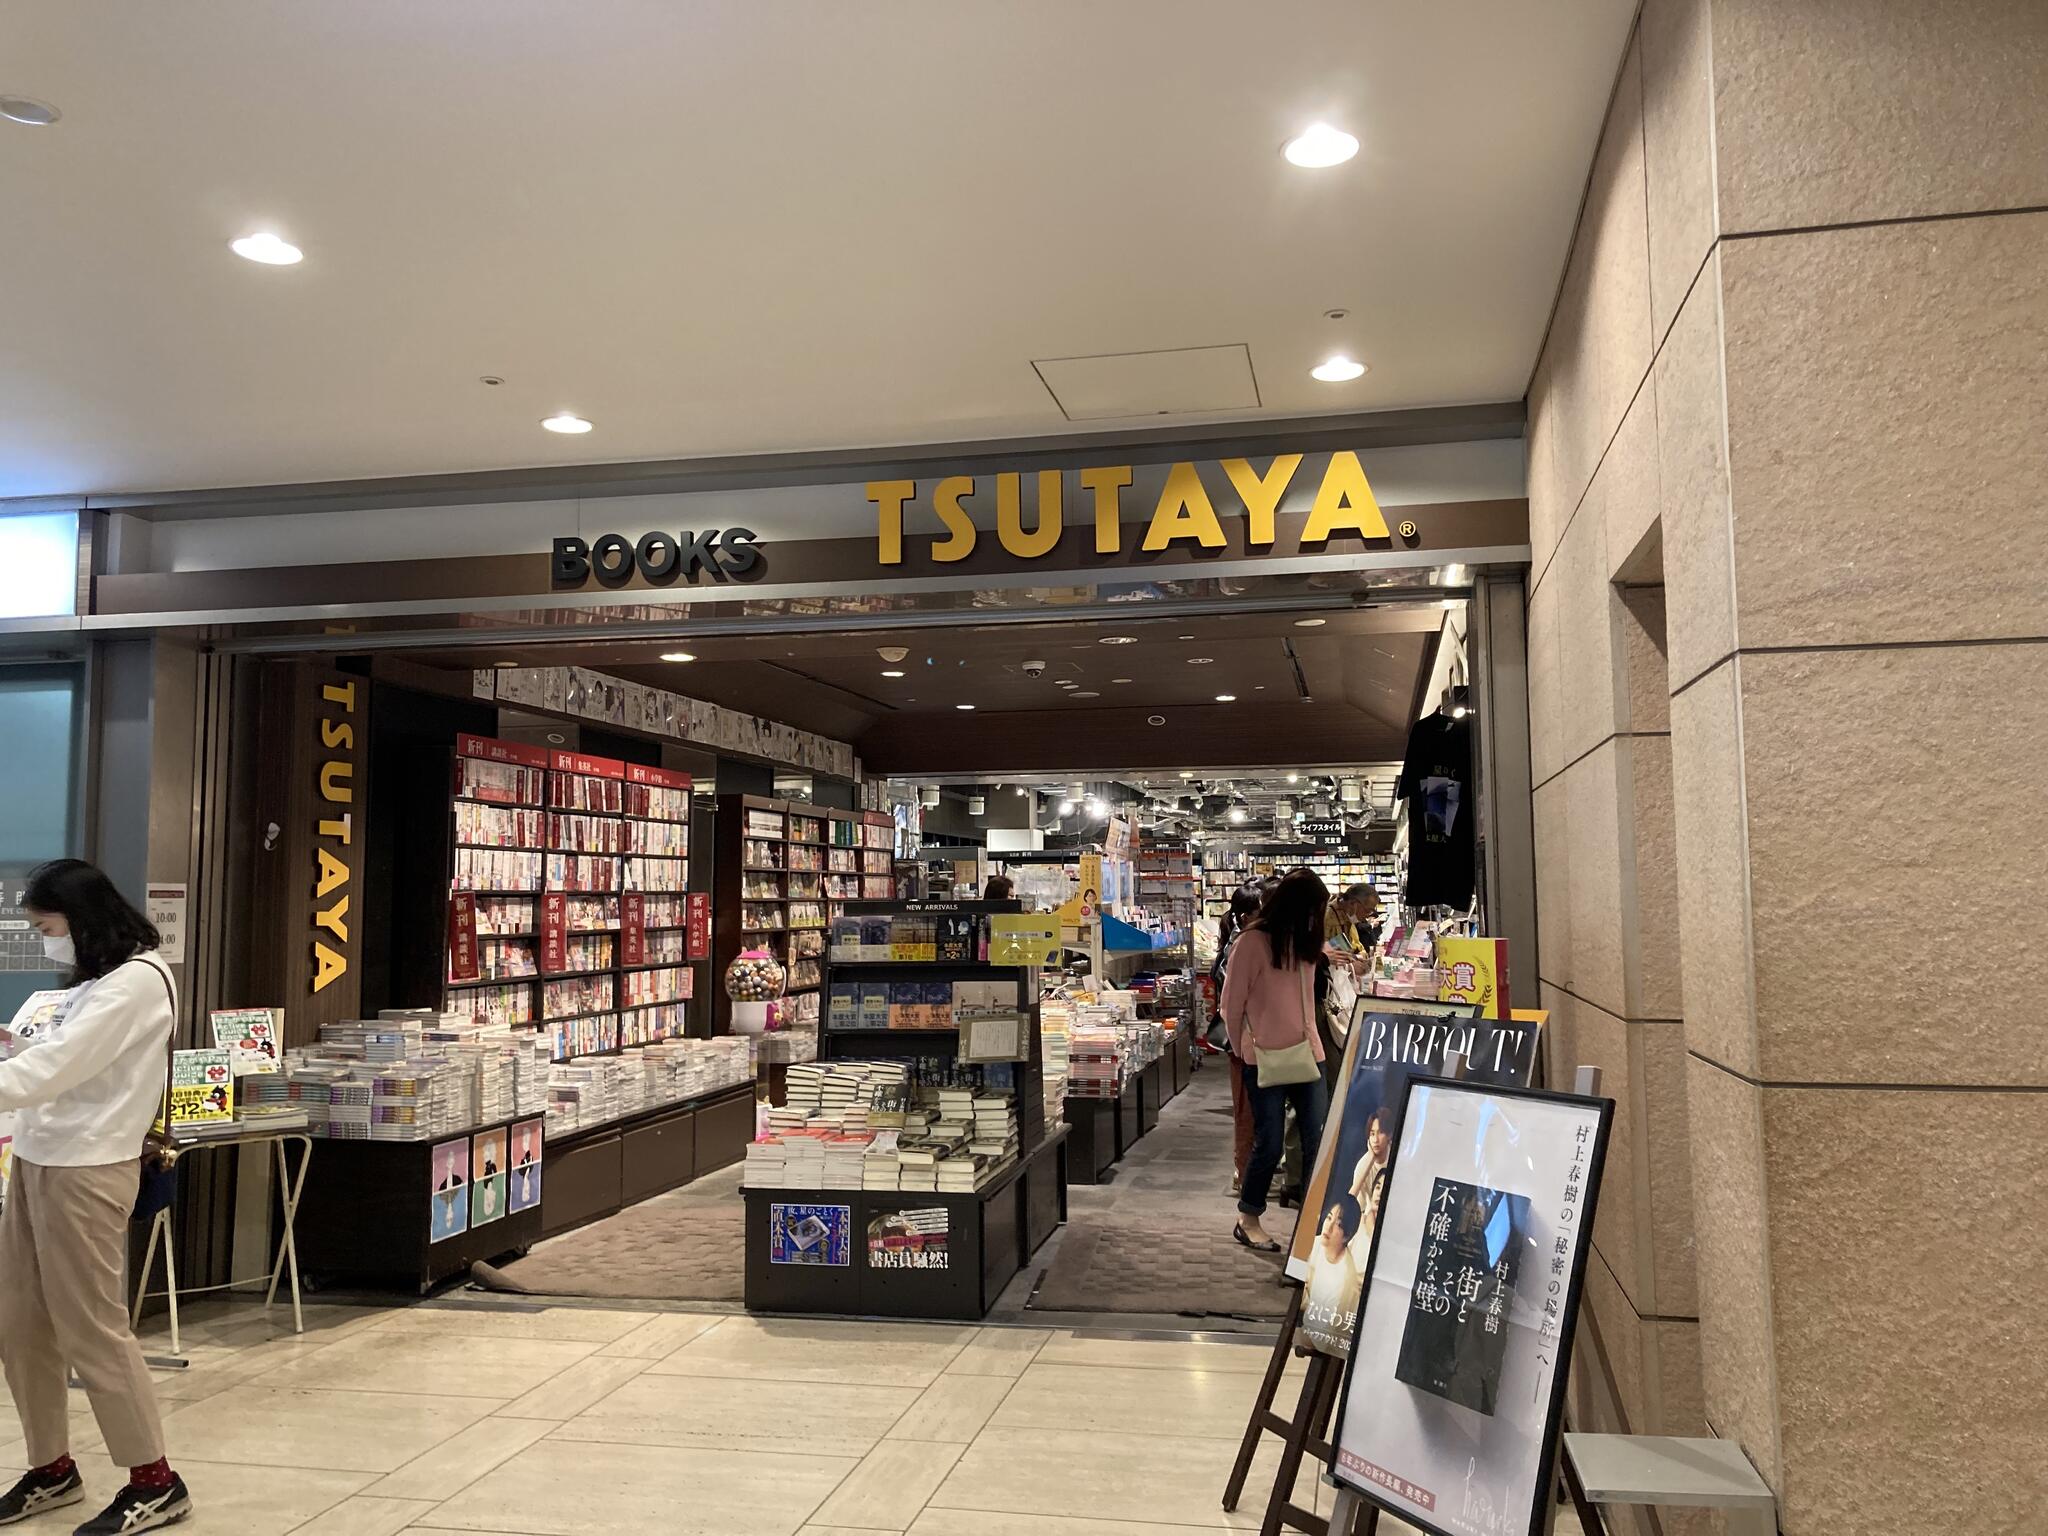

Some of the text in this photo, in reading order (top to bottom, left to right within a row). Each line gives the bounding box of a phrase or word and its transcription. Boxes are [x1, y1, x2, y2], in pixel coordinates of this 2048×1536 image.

[552, 451, 1391, 590] BOOKS TSUTAYA
[558, 754, 573, 770] 新刊
[313, 681, 356, 993] TSUTAYA
[1301, 823, 1341, 833] ライフスタイル
[155, 912, 177, 924] 10:00
[455, 896, 469, 928] 新刊
[547, 897, 561, 924] 新刊
[627, 897, 639, 923] 新刊
[692, 896, 704, 920] 新刊
[906, 903, 959, 912] NEW ARRIVALS
[1364, 1020, 1524, 1075] BARFOUT!
[1414, 1183, 1458, 1314] 不確かな壁
[1435, 1271, 1455, 1316] その
[1455, 1265, 1484, 1323] 街と
[1484, 1261, 1510, 1335] 村上春樹
